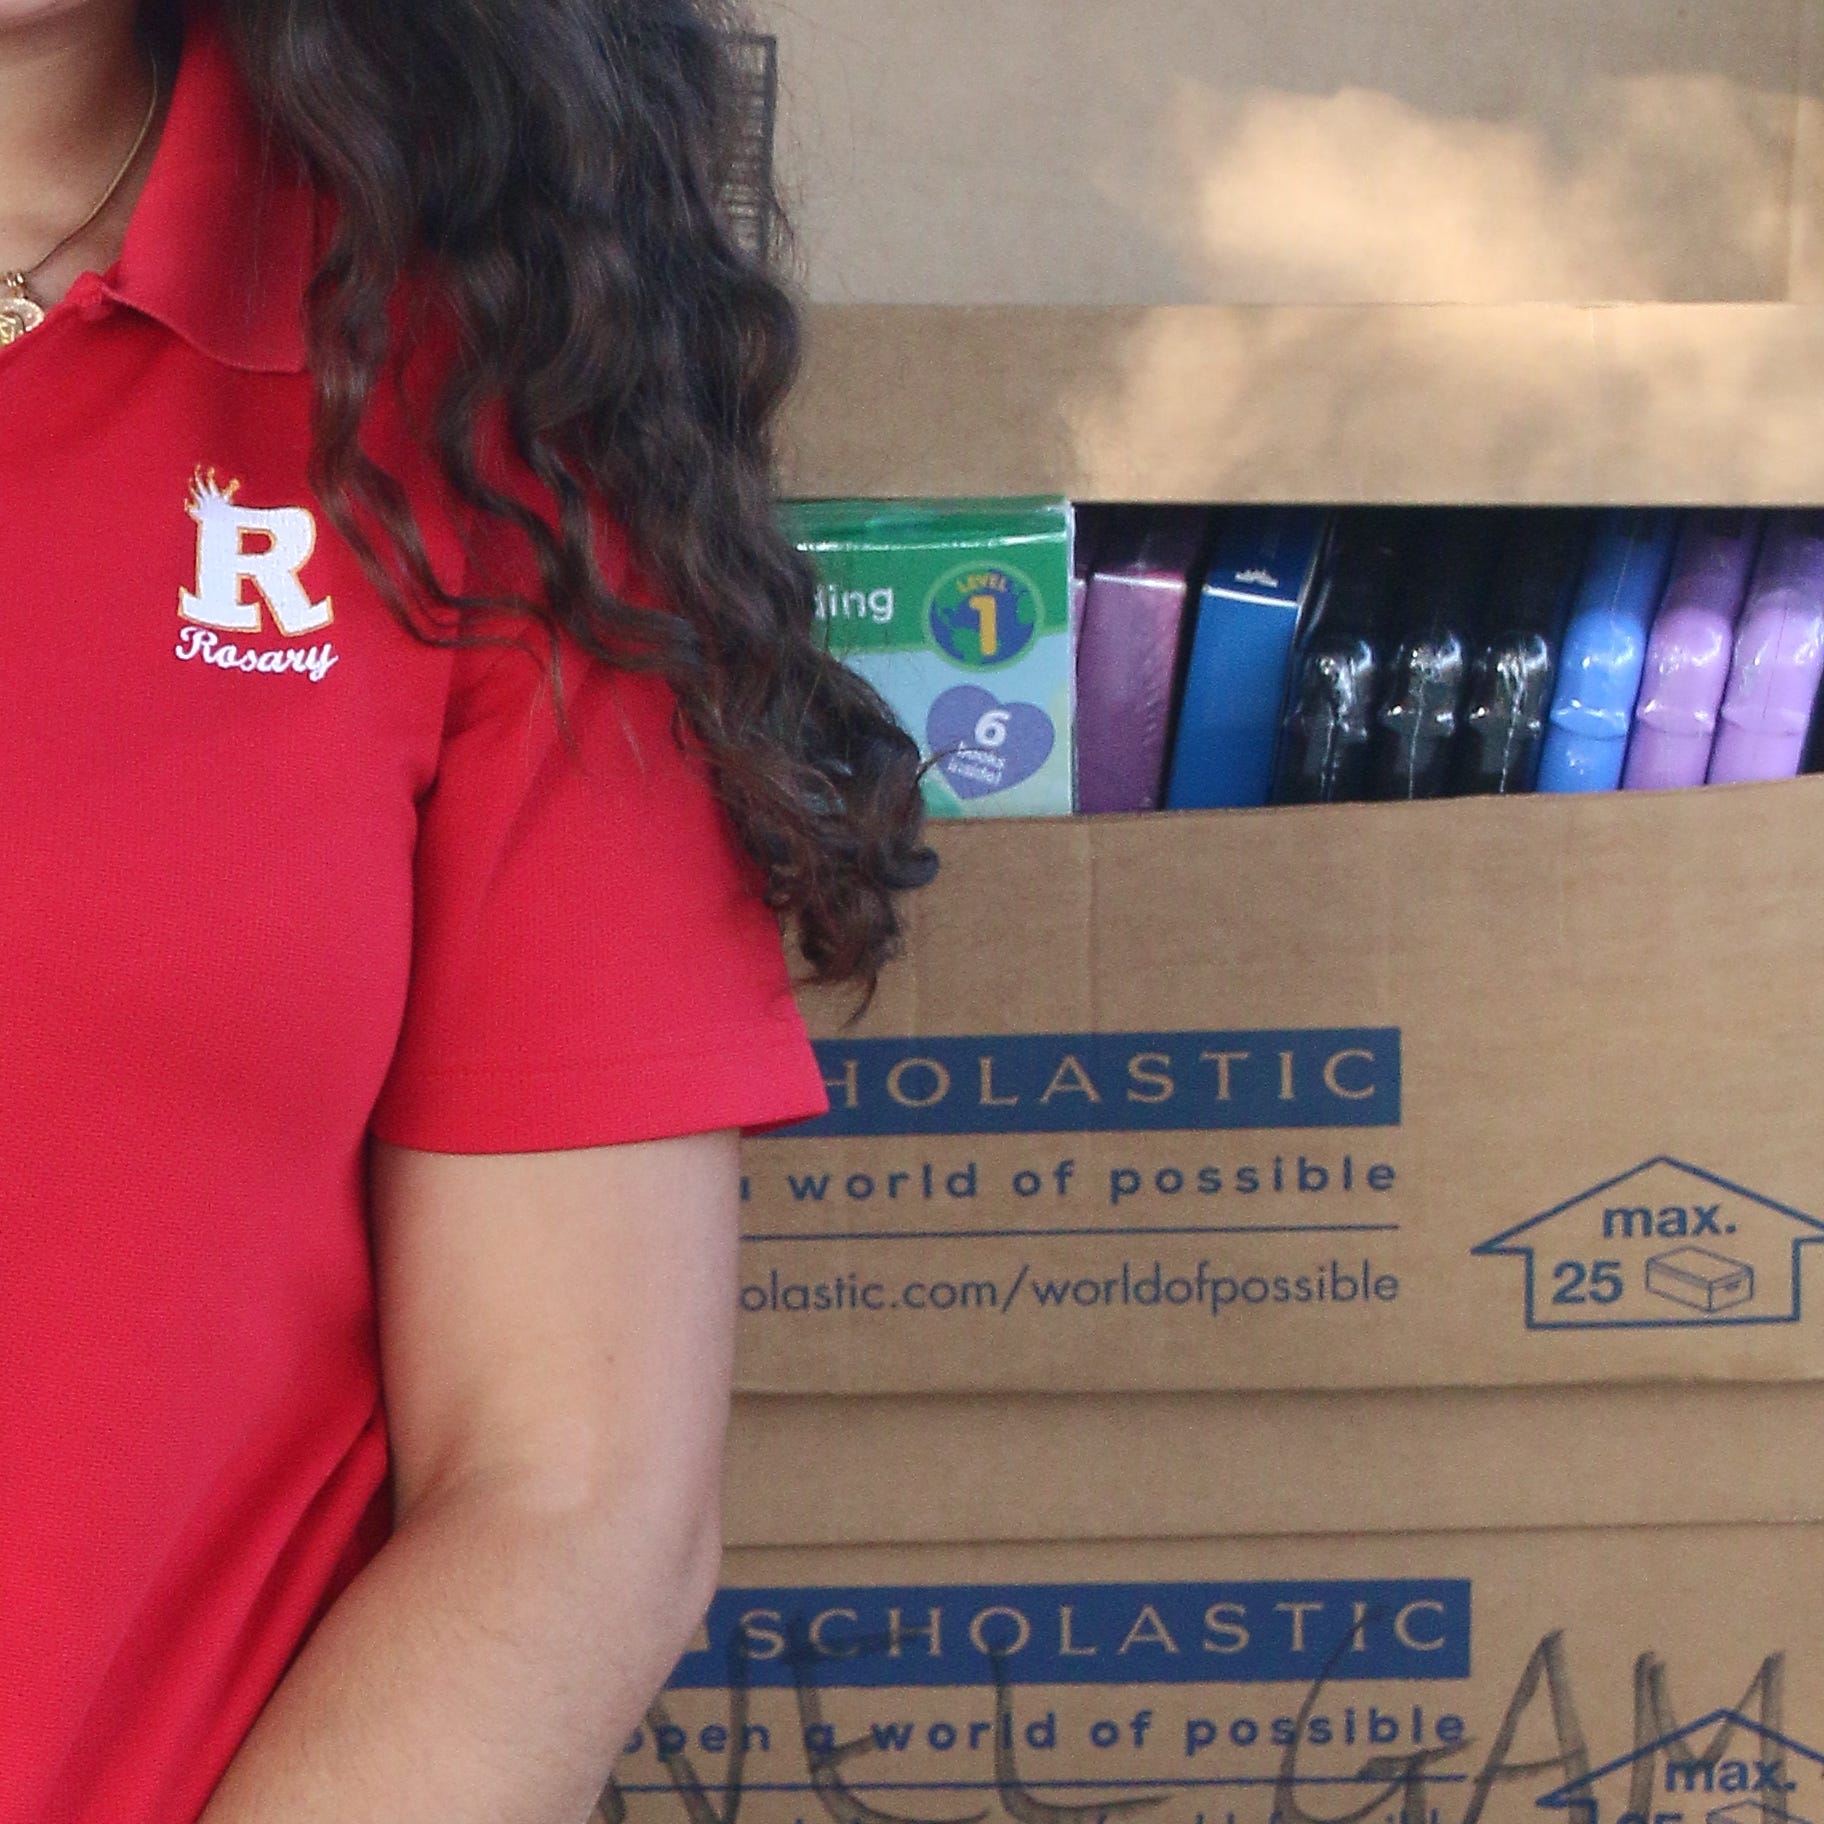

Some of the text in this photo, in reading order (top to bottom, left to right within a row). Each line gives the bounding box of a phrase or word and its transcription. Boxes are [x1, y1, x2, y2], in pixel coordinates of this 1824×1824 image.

[177, 503, 334, 638] R
[968, 594, 998, 657] 1
[175, 625, 339, 682] Rosary
[974, 709, 1012, 748] 6
[786, 1161, 977, 1201] world
[1012, 1158, 1075, 1198] of
[1108, 1153, 1397, 1206] possible
[1602, 1203, 1738, 1239] max.
[739, 1257, 1400, 1317] olastic.com/worldofpossible
[1551, 1258, 1625, 1306] 25
[738, 1600, 1446, 1660] SCHOLASTIC
[803, 1720, 837, 1754] a
[871, 1710, 1057, 1752] world
[1089, 1709, 1153, 1748] of
[1185, 1704, 1466, 1757] possible
[1664, 1756, 1798, 1794] max.
